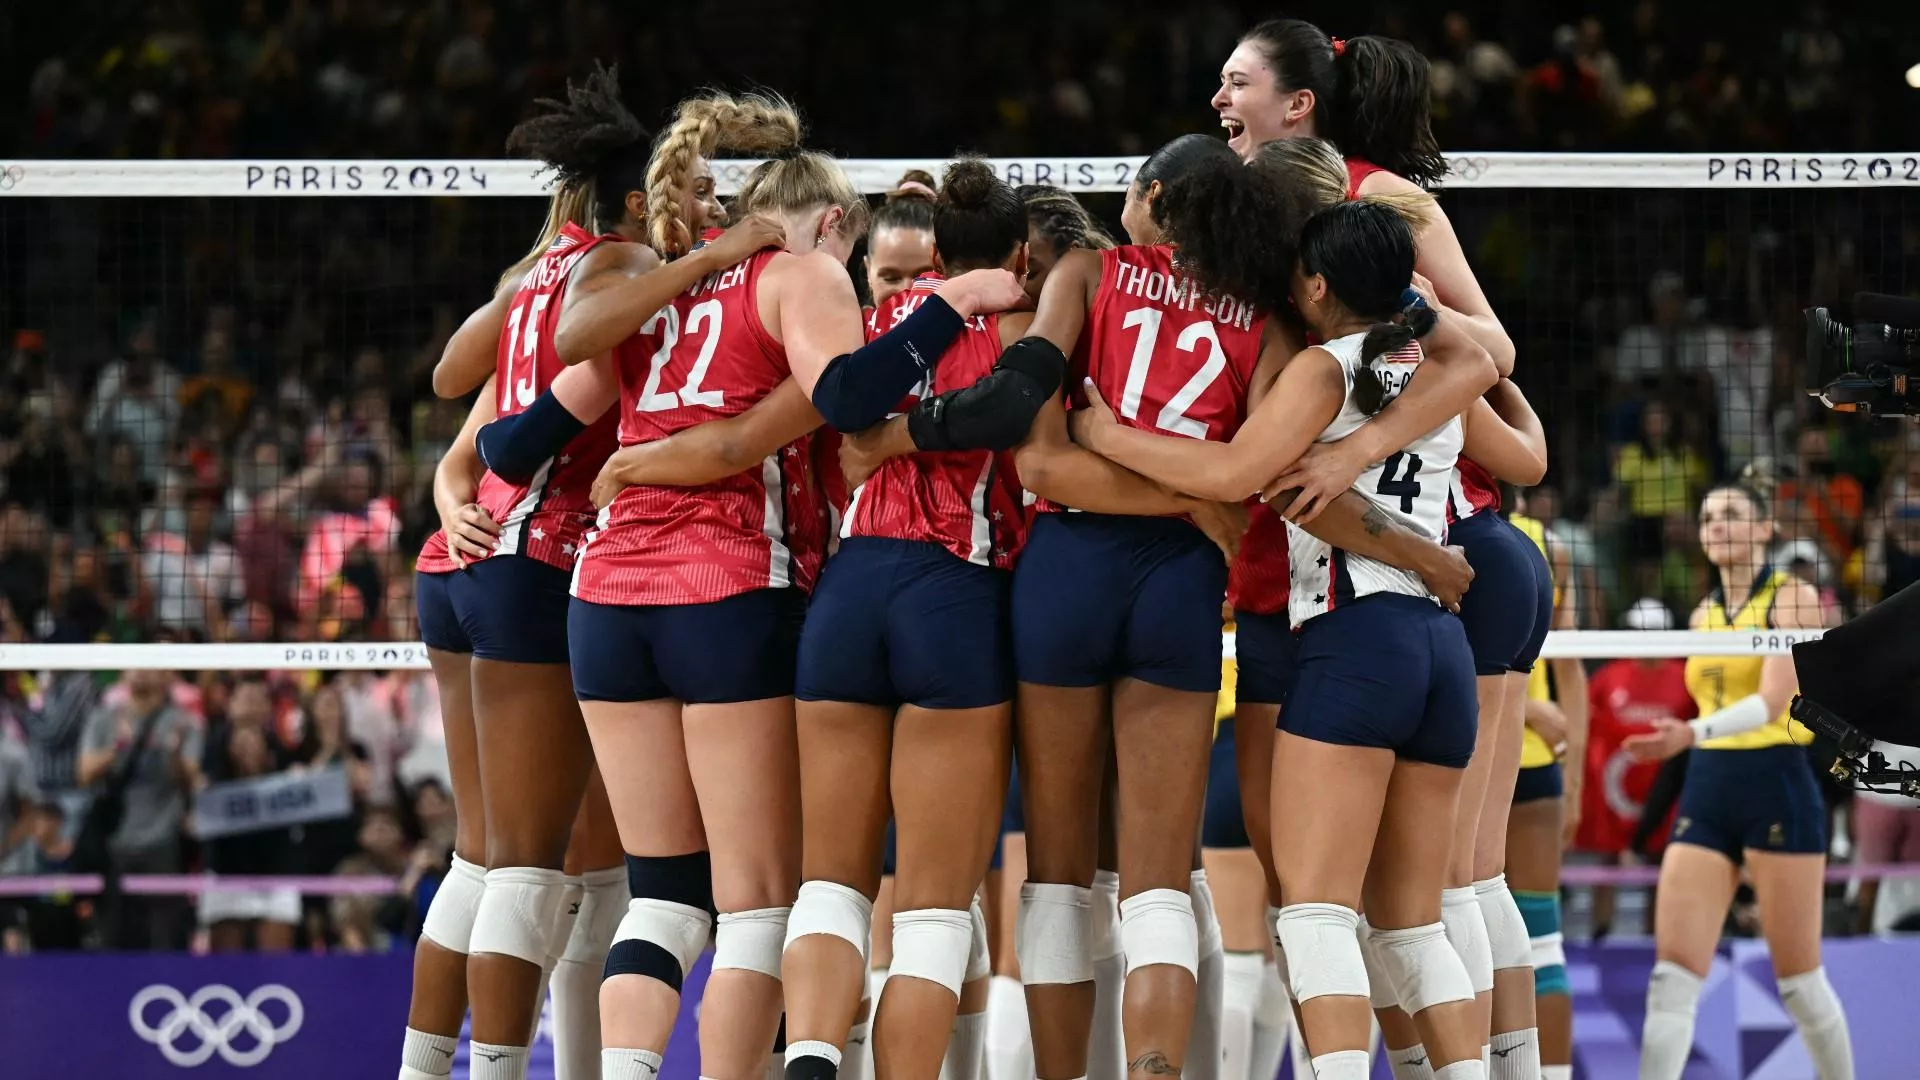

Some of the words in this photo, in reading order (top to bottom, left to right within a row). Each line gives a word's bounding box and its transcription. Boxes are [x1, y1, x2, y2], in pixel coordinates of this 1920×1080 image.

[246, 165, 363, 190] PARIS
[381, 165, 487, 191] 2024
[991, 162, 1095, 187] ARIS
[1708, 158, 1822, 182] PARIS
[1841, 157, 1919, 181] 202
[502, 294, 550, 412] 15
[636, 299, 725, 412] 22
[1120, 306, 1227, 441] 12
[1376, 450, 1423, 514] 4
[285, 648, 355, 662] PARIS
